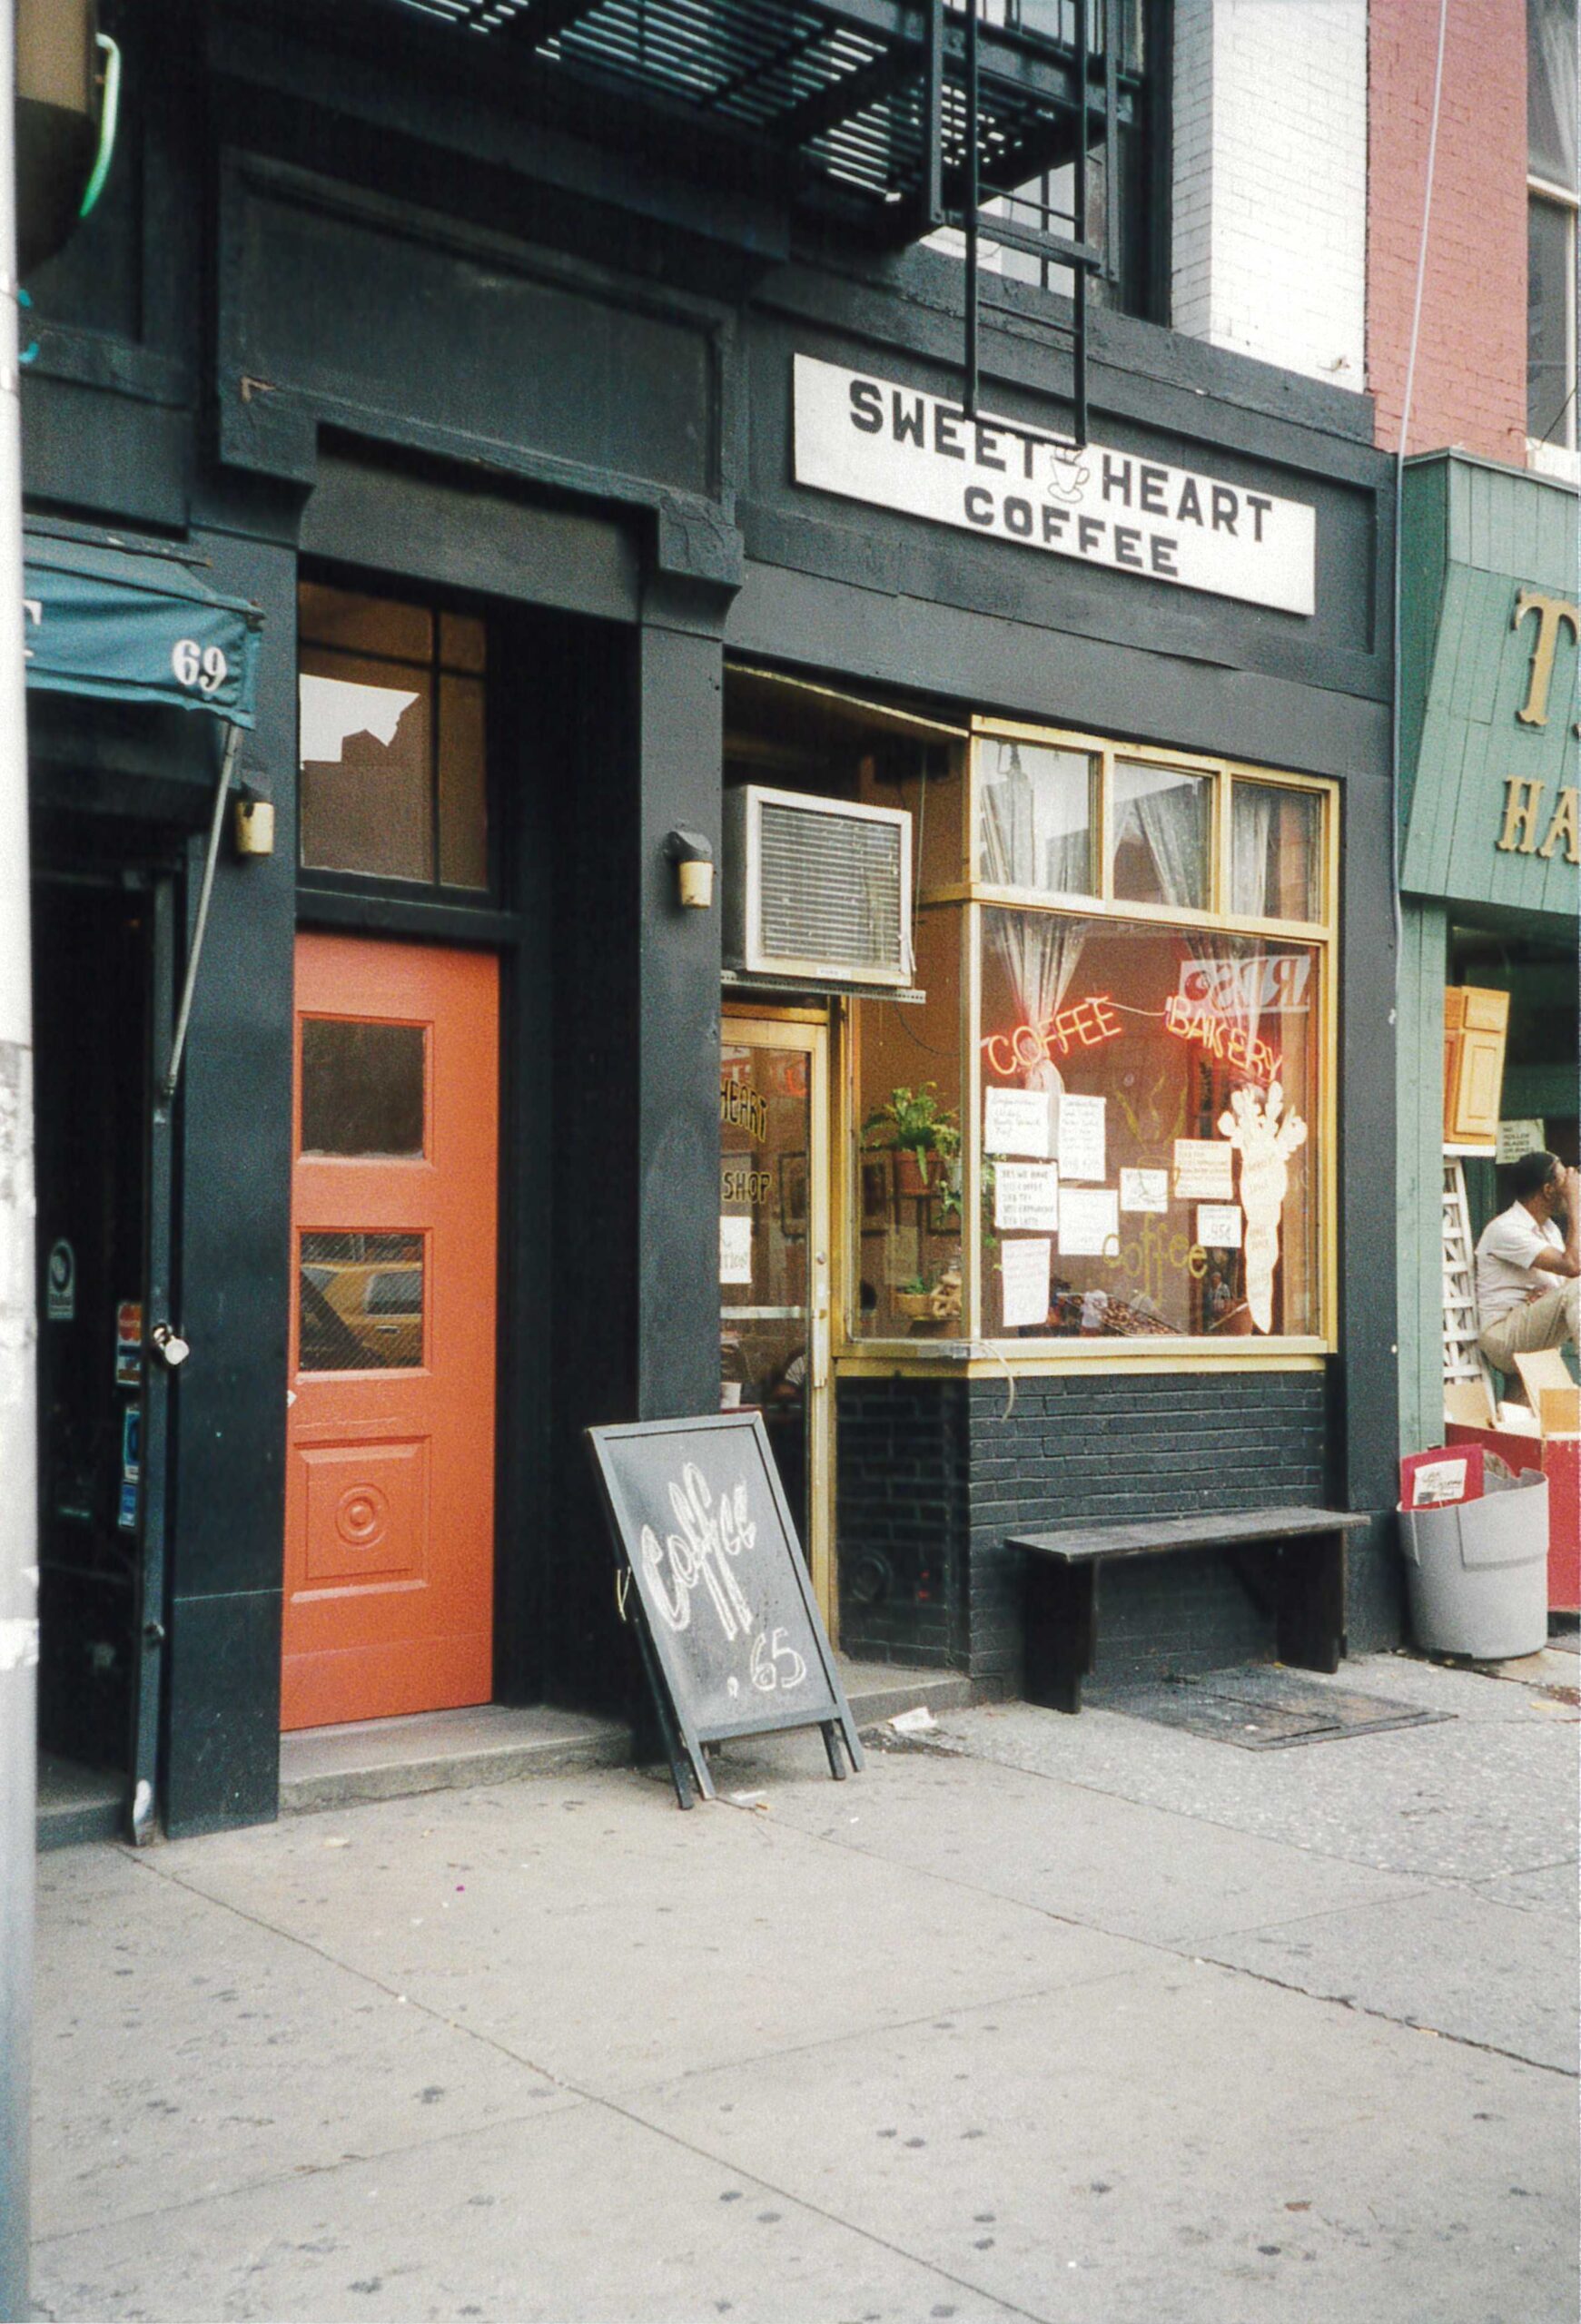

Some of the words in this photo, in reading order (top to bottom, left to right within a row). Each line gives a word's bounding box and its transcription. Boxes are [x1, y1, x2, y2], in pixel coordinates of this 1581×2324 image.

[849, 379, 1045, 480] SWEET
[1102, 454, 1272, 542] HEART
[963, 486, 1179, 576] COFFEE
[173, 639, 227, 692] 69
[988, 996, 1122, 1075] COFFEE
[1167, 995, 1284, 1082] BAKERY
[723, 1171, 771, 1205] SHOP
